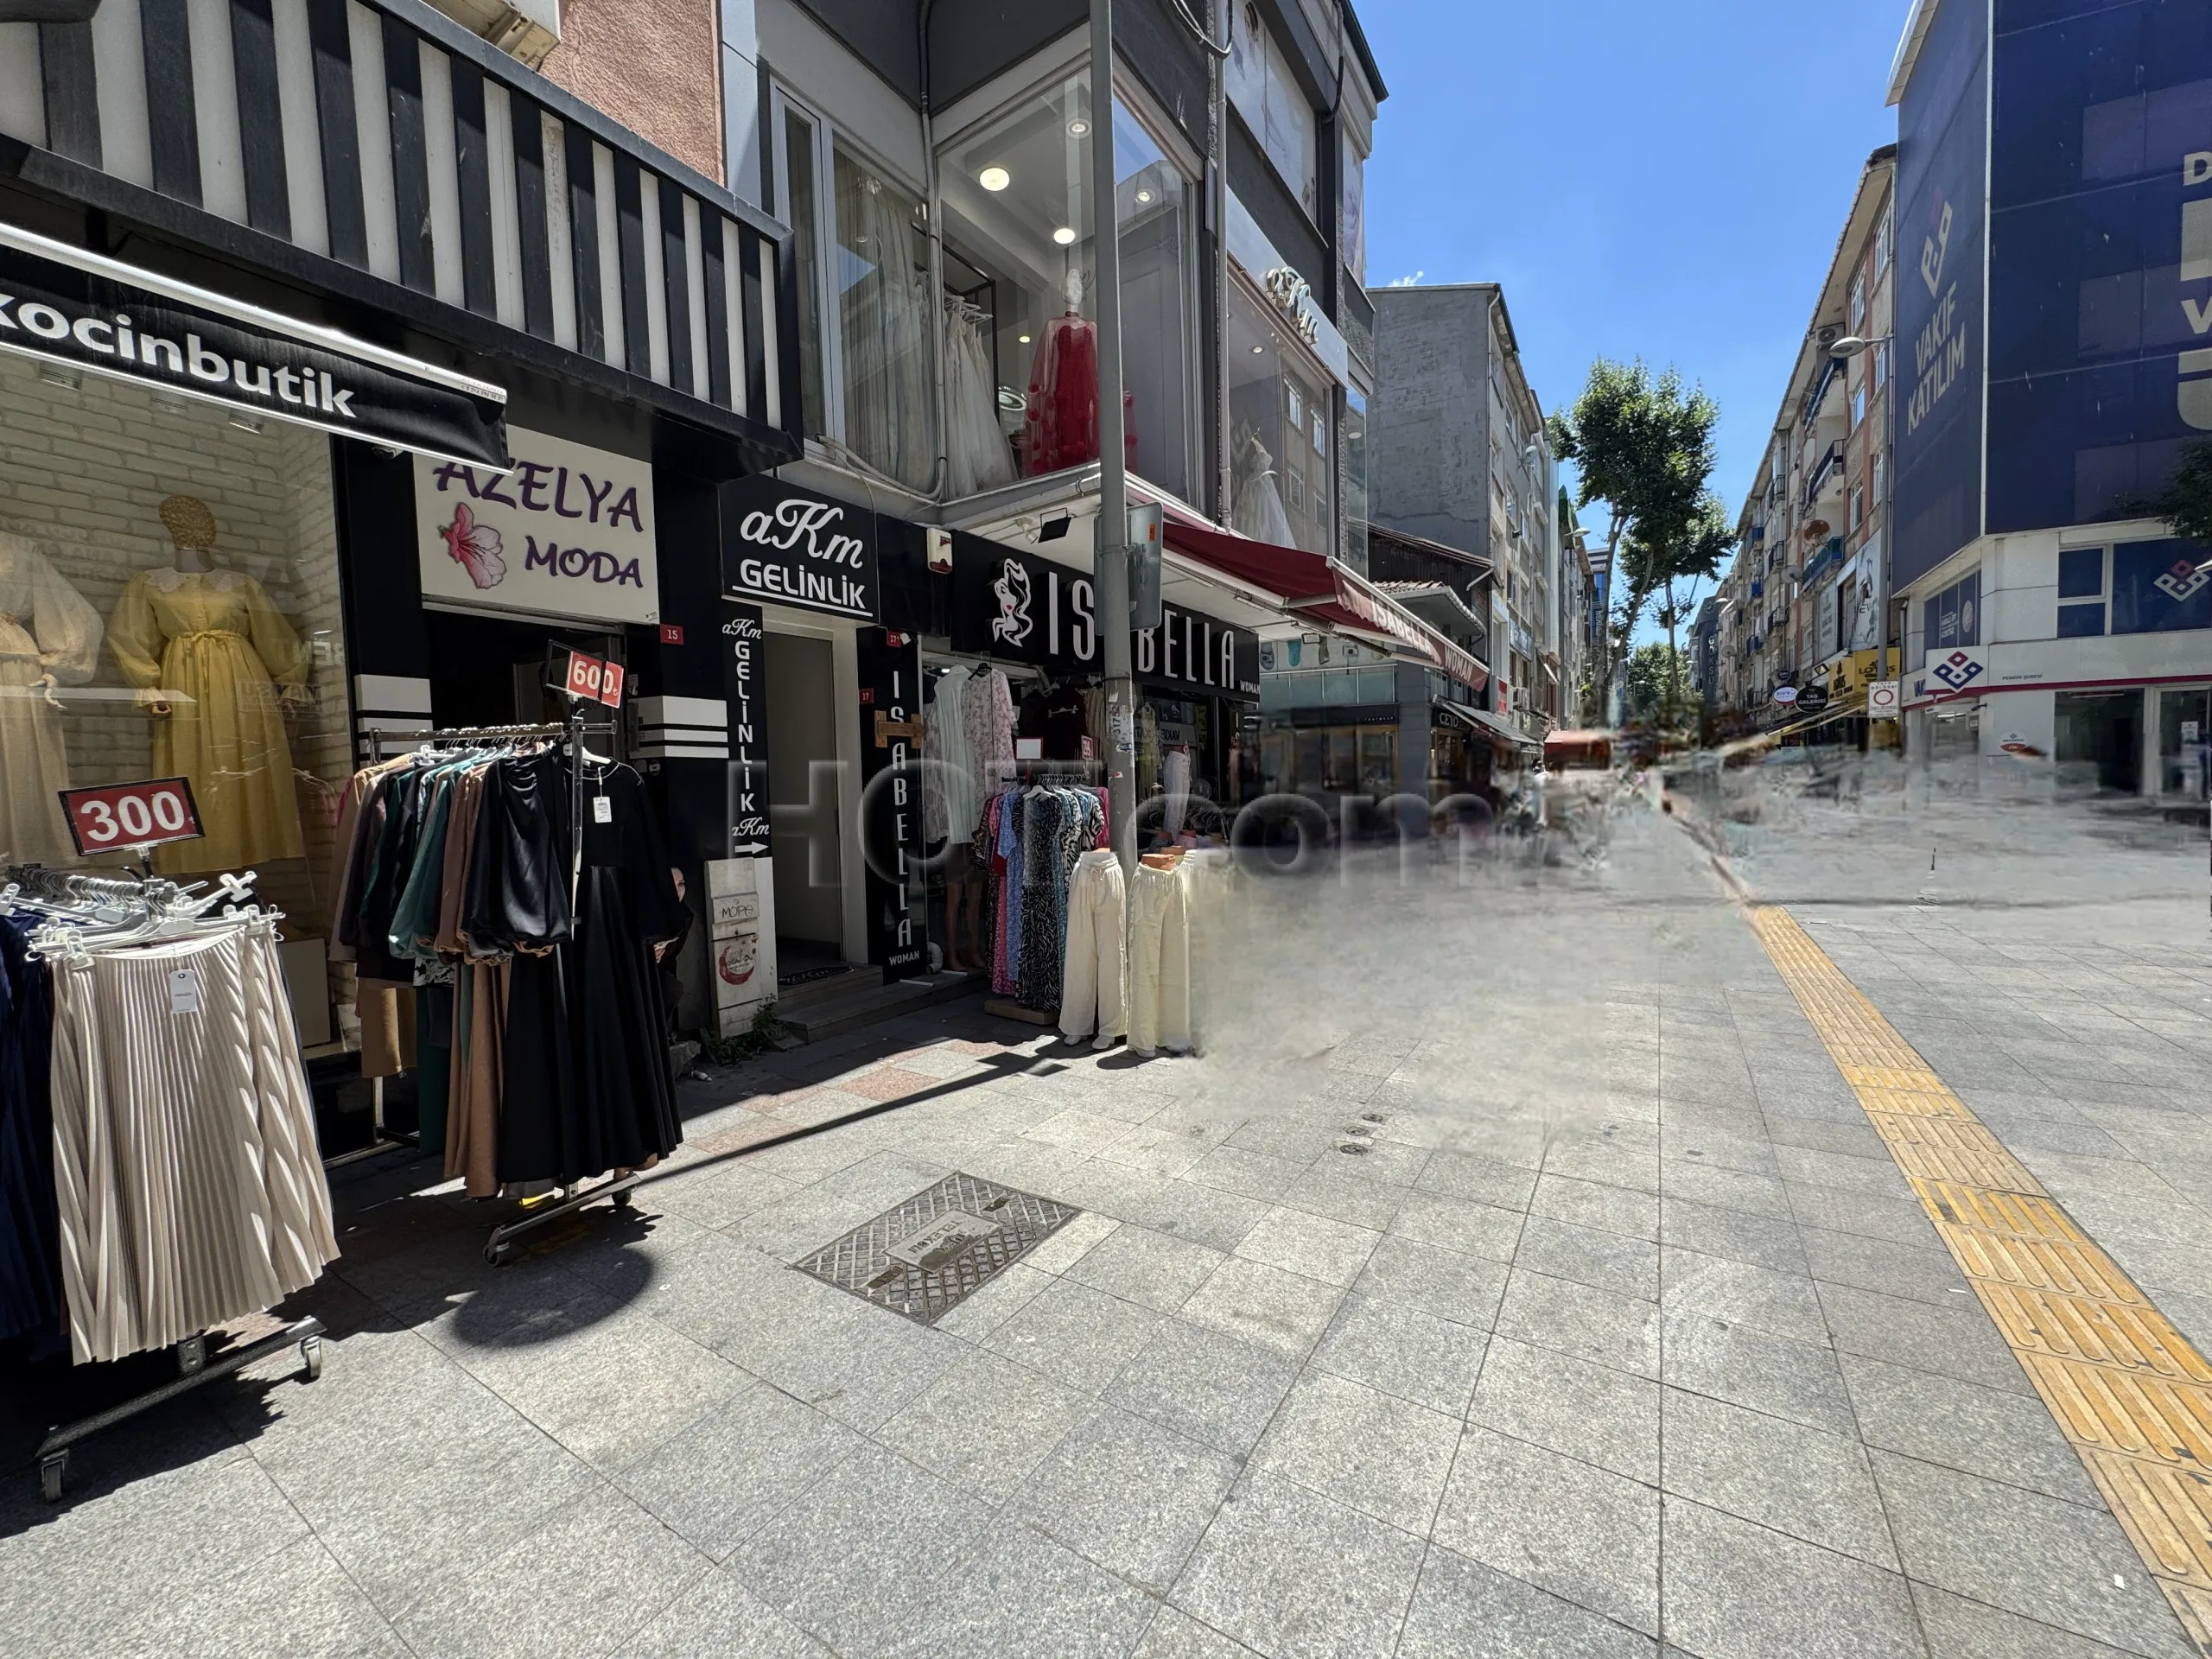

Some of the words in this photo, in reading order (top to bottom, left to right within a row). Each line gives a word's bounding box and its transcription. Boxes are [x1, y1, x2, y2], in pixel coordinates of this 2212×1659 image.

[1915, 280, 1956, 377] VAKIF
[1907, 321, 1966, 436] KATILIM
[433, 457, 644, 533] AZELYA
[524, 535, 644, 588] MODA
[740, 558, 867, 610] GELİNLİK
[667, 629, 678, 640] 15
[1048, 571, 1235, 690] ISBELLA
[573, 660, 614, 694] 600
[1444, 644, 1473, 682] WOMAN
[1859, 664, 1896, 675] LOTS
[862, 692, 869, 701] 17
[1240, 679, 1261, 696] WOMAN
[734, 640, 755, 812] GELİNLİK
[1439, 712, 1459, 728] CEYO
[80, 791, 184, 842] 300
[888, 950, 920, 966] WOMAN
